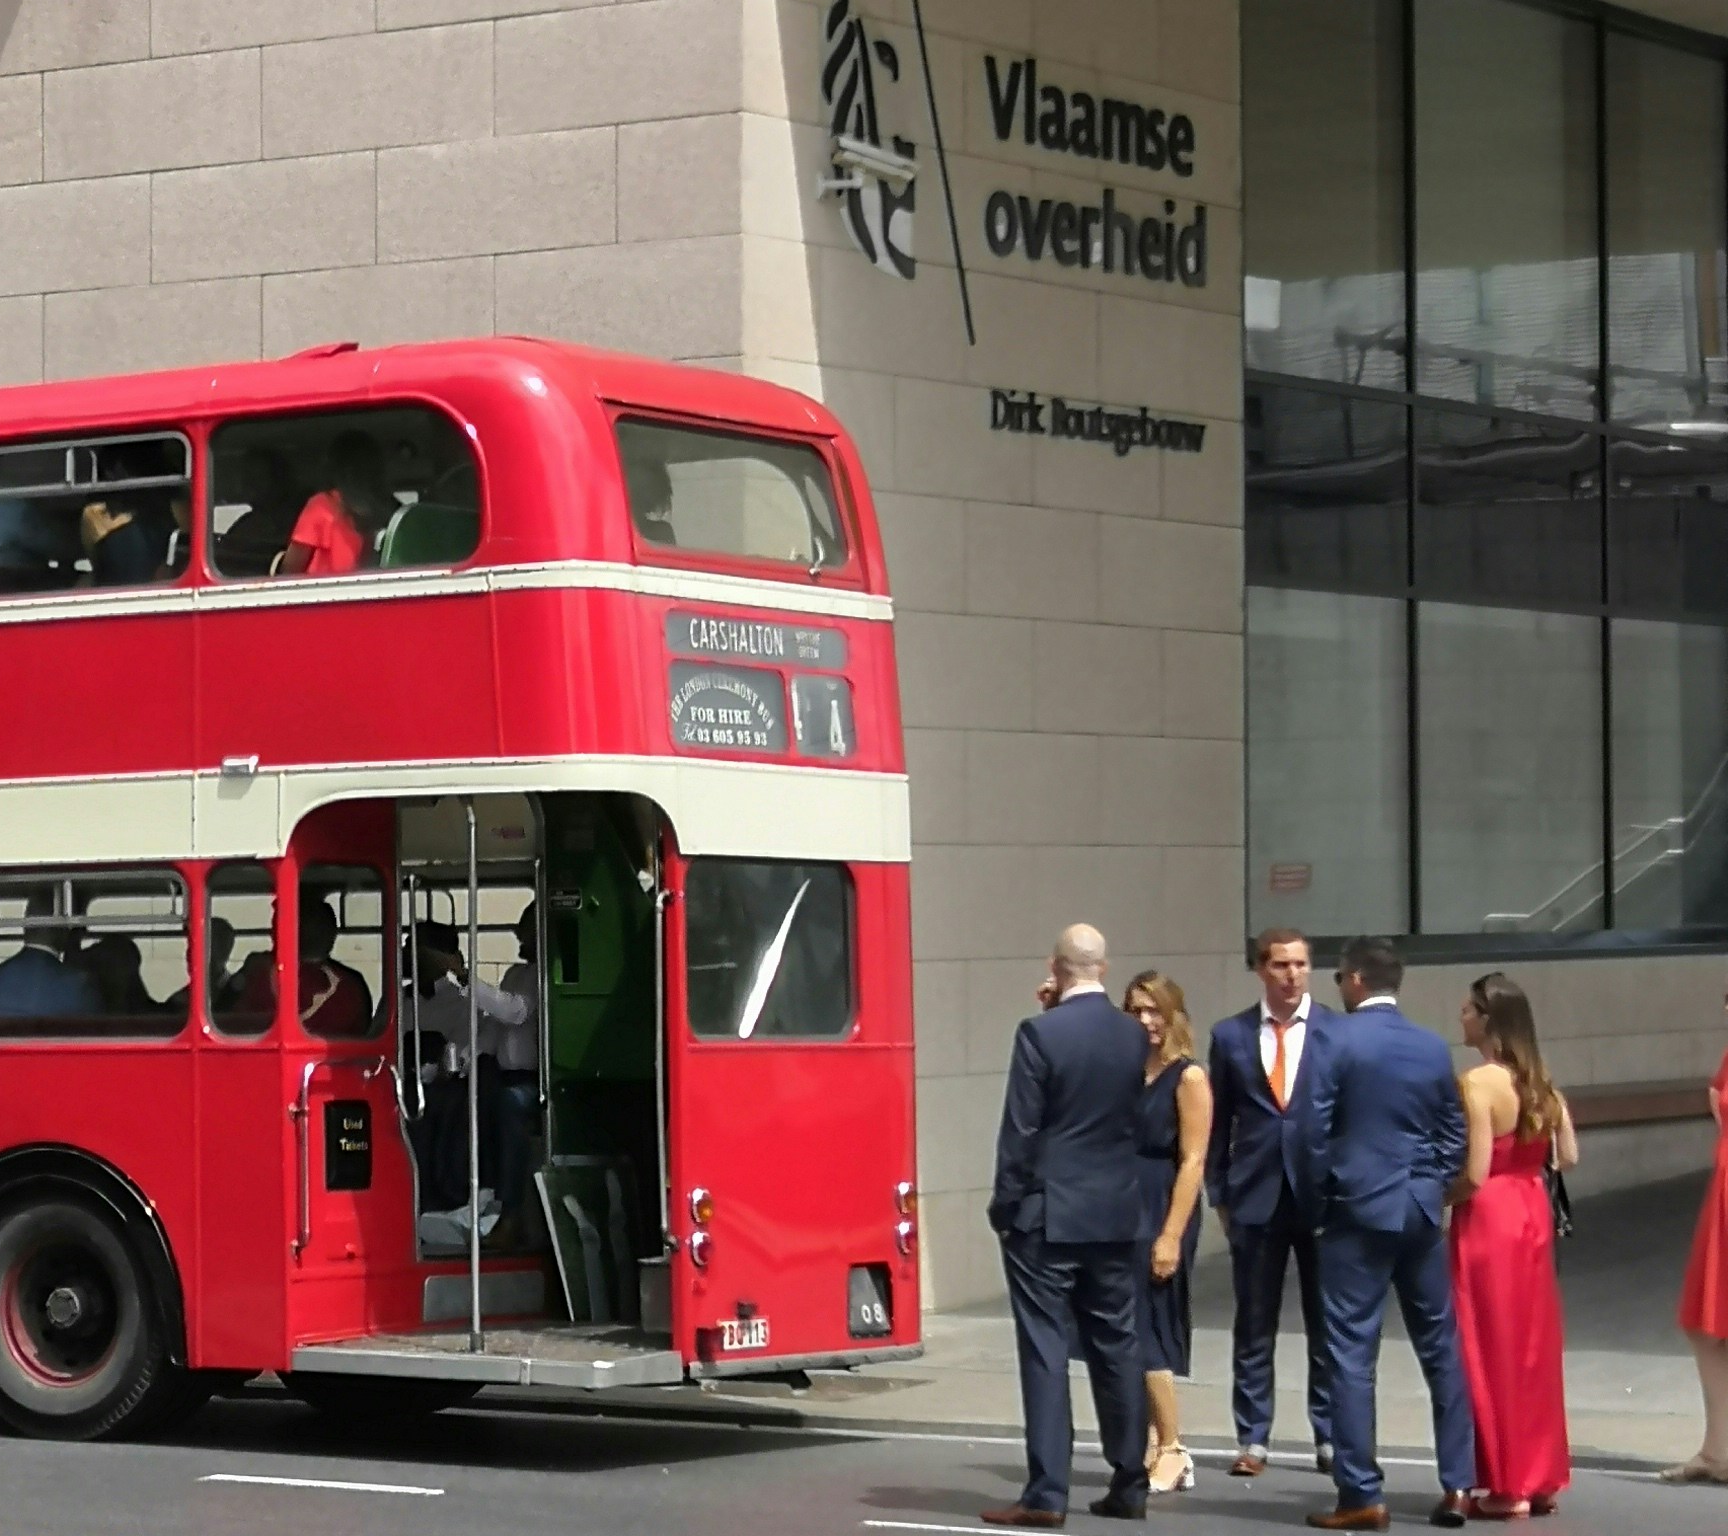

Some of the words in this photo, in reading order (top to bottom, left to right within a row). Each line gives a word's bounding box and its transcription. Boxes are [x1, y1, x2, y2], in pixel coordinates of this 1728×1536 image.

[985, 55, 1195, 177] Vlaamse
[985, 188, 1206, 287] overheid
[991, 388, 1046, 434] Dirk
[690, 618, 784, 656] CARSHALTON
[671, 694, 684, 722] THE
[680, 673, 711, 703] LONDON
[690, 706, 716, 723] FOR
[718, 708, 752, 725] HIRE
[697, 727, 710, 743] 03
[712, 729, 734, 744] 605
